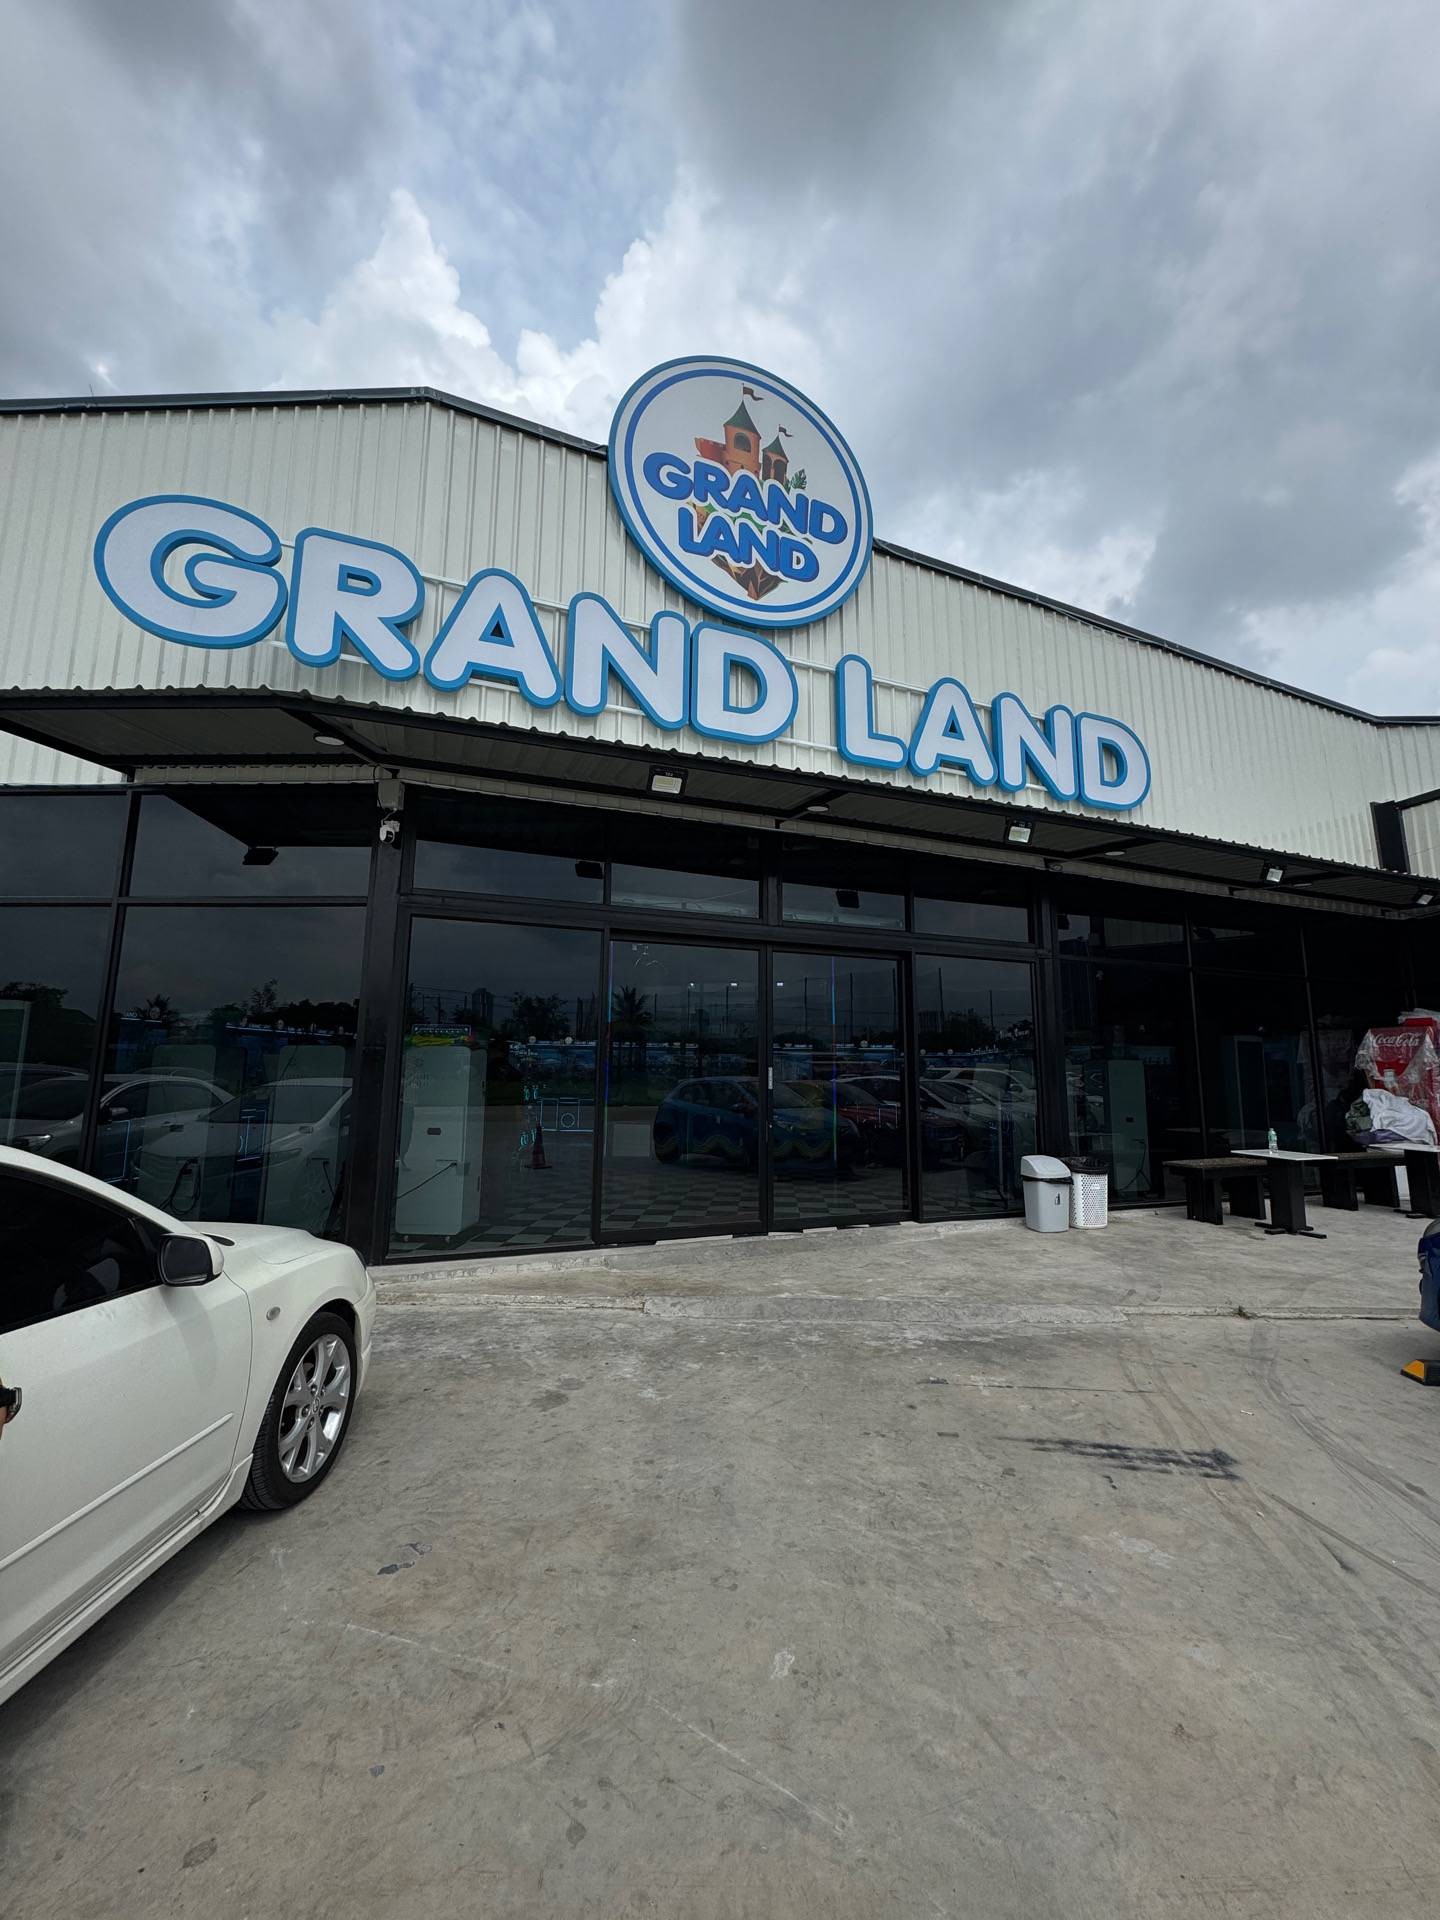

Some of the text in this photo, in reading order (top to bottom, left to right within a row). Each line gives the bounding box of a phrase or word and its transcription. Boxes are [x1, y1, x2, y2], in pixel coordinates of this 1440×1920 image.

[643, 452, 848, 545] GRAND
[677, 507, 820, 582] LAND
[93, 494, 1152, 811] GRAND LAND
[1373, 1032, 1422, 1047] CocaCola
